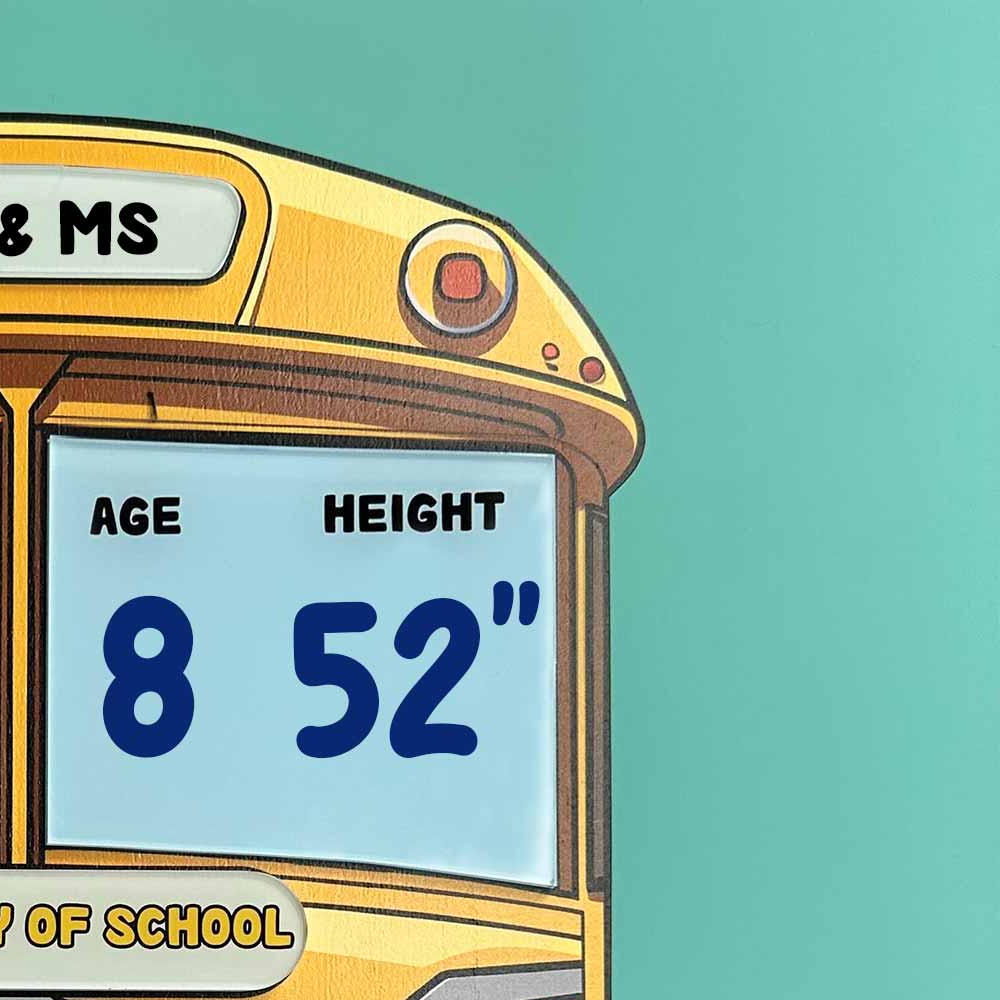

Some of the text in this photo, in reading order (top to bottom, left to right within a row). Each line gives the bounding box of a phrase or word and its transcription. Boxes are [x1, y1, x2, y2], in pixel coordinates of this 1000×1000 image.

[60, 200, 159, 256] MS
[89, 496, 182, 536] AGE
[323, 491, 505, 534] HEIGHT
[102, 580, 540, 759] 8 52"
[25, 902, 93, 949] OF
[104, 902, 295, 951] SCHOOL
